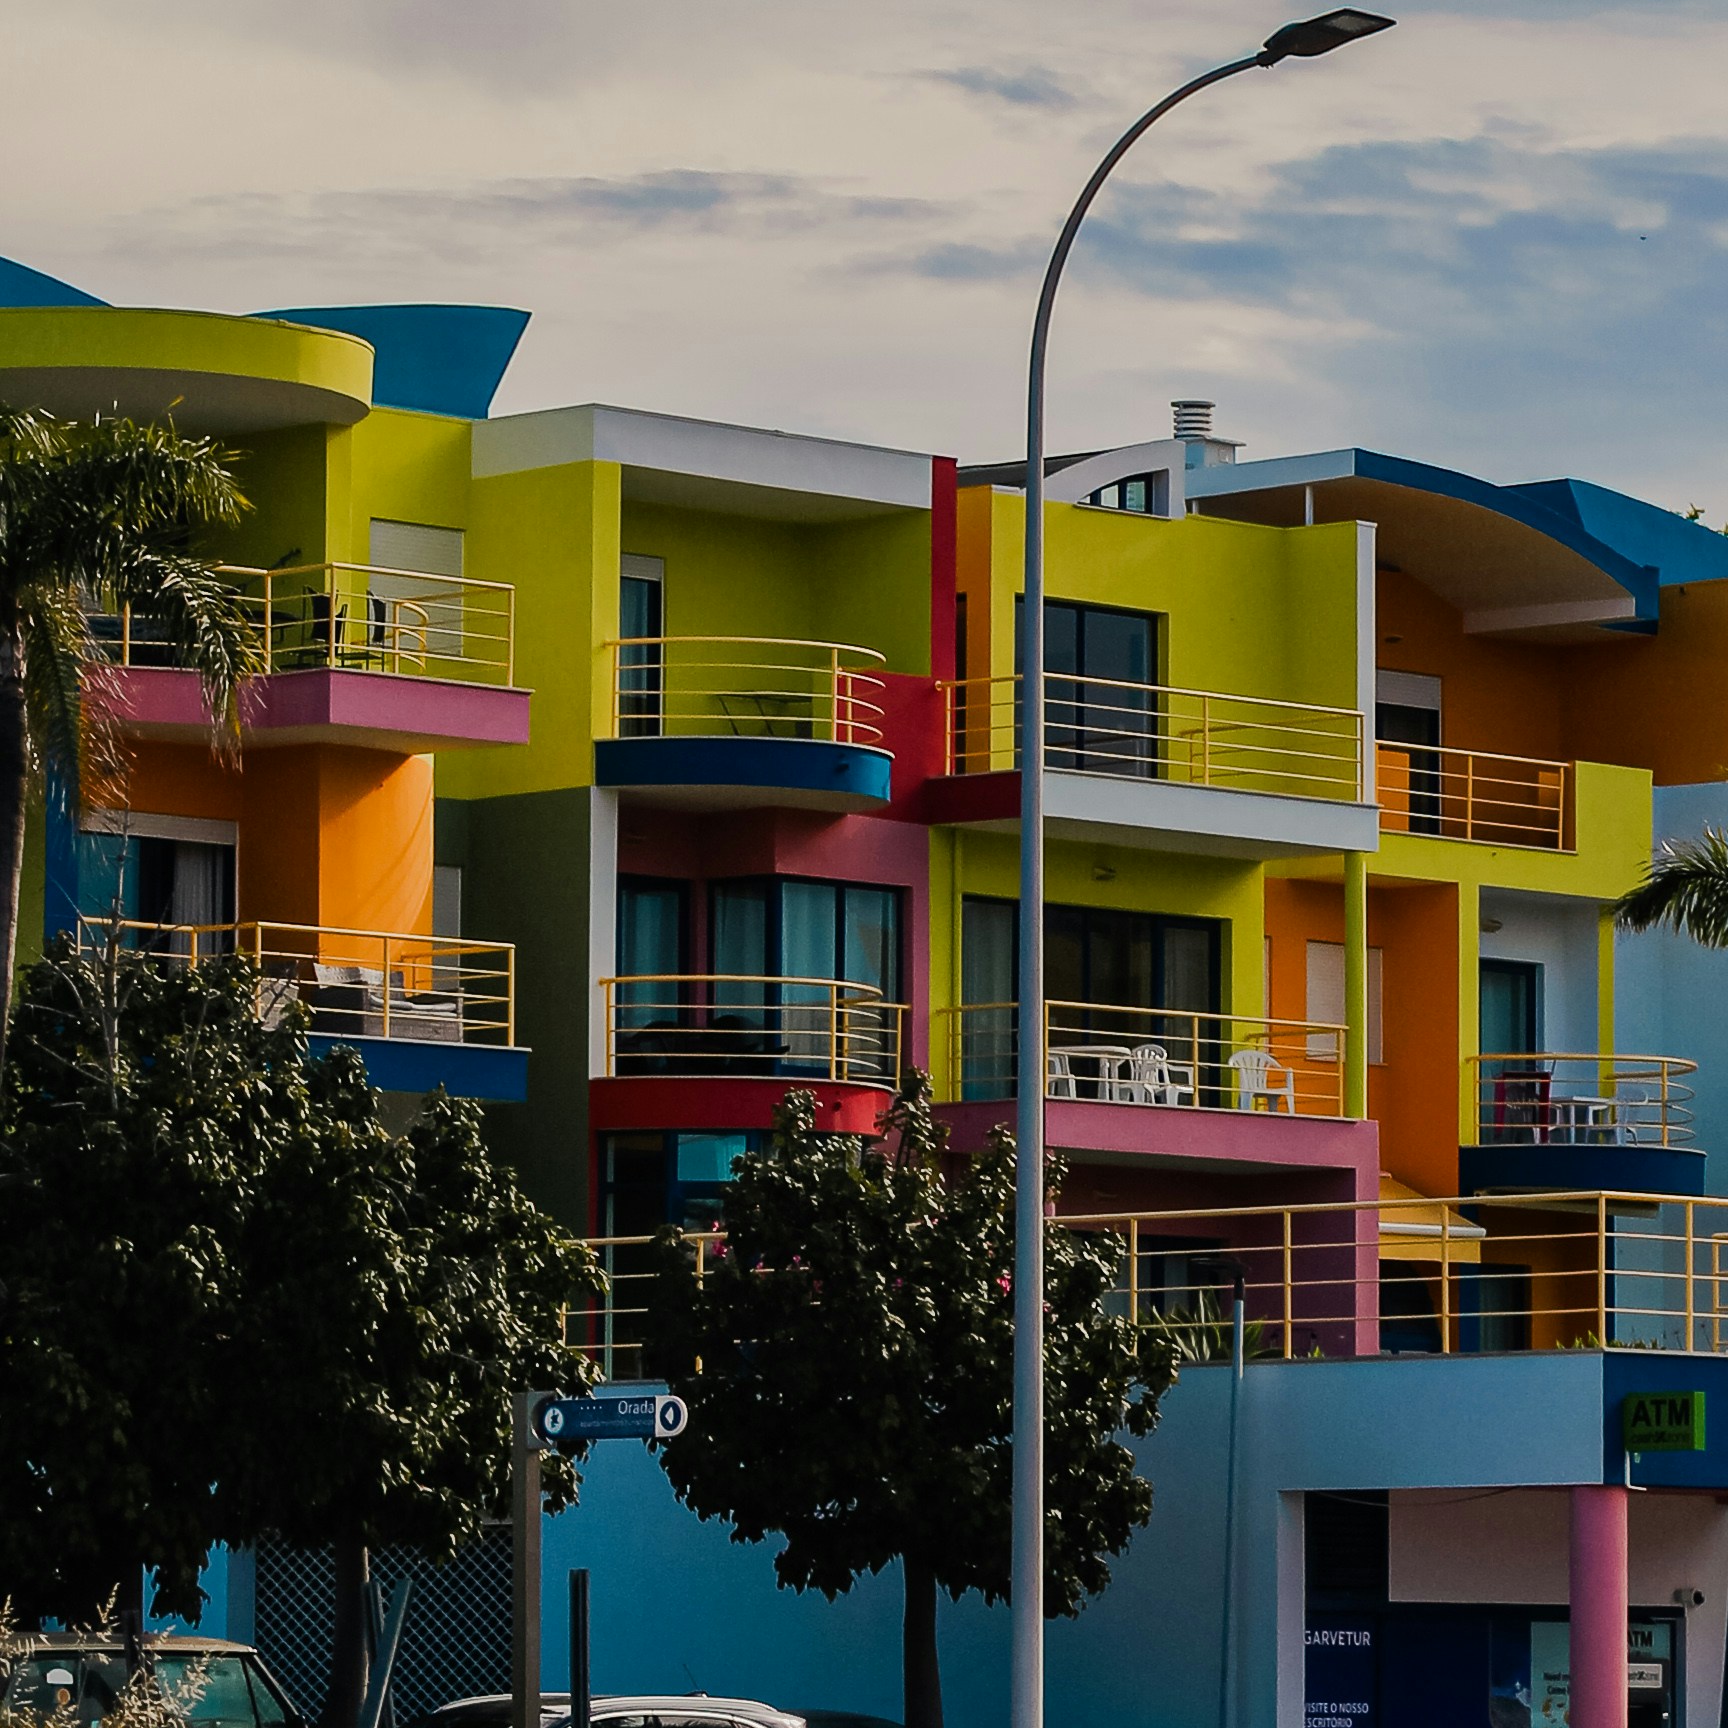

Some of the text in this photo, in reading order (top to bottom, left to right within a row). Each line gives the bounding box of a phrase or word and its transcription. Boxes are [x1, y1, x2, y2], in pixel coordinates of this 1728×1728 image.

[617, 1400, 655, 1415] Orada
[1631, 1398, 1690, 1427] ATM
[1304, 1630, 1371, 1647] GARVETUR
[1339, 1702, 1369, 1714] NOSSO
